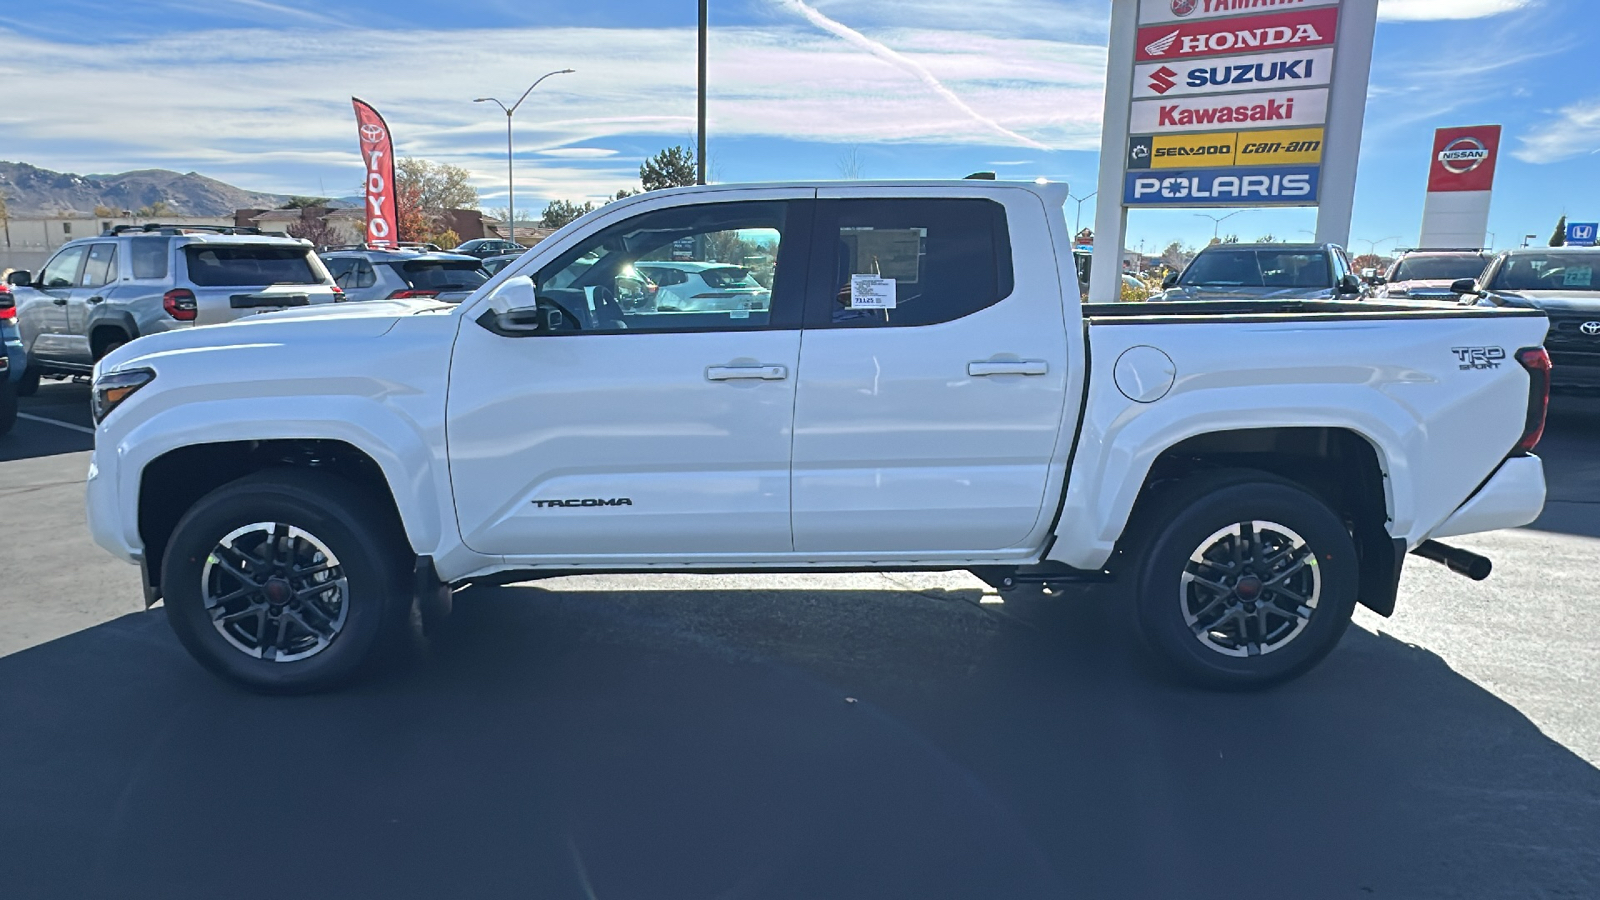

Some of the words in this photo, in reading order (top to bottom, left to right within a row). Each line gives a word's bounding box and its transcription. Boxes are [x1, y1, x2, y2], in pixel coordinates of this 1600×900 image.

[1203, 0, 1304, 12] YAMA
[1180, 24, 1322, 53] HONDA
[1186, 59, 1314, 87] SUZUKI
[1159, 98, 1294, 126] Kawasaki
[1242, 141, 1321, 154] can-am
[1443, 151, 1484, 160] NISSAN
[1134, 174, 1311, 198] POLARIS
[1451, 346, 1506, 364] TRD
[531, 498, 633, 508] TACOMA
